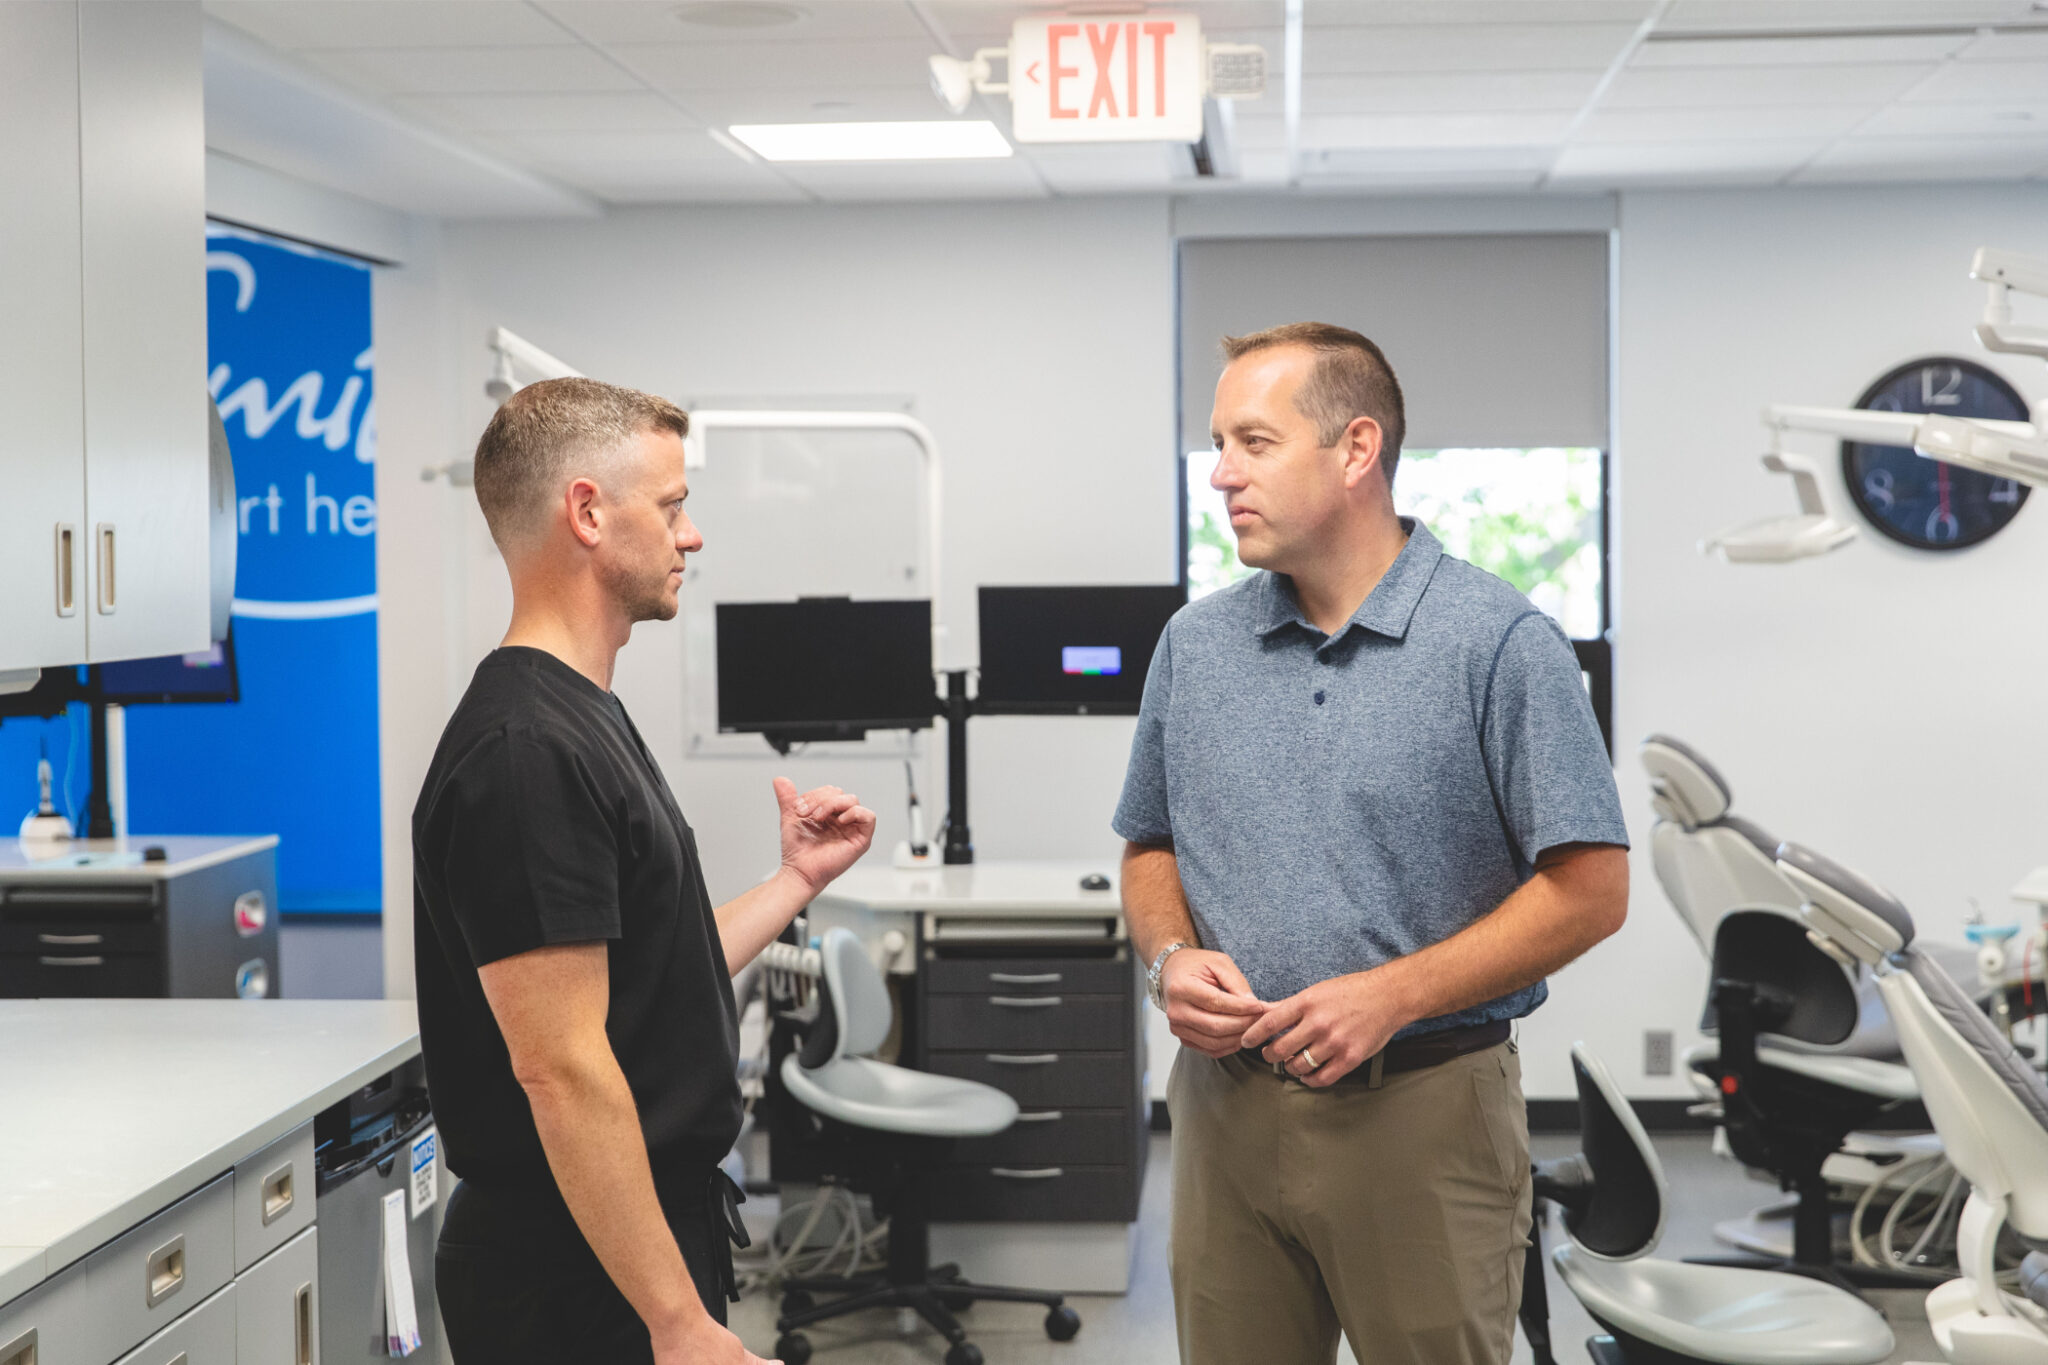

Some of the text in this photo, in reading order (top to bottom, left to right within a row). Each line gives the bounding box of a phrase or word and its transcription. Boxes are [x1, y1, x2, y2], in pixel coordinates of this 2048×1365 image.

[1047, 22, 1175, 119] EXIT
[1921, 366, 1962, 406] 12
[1864, 468, 1895, 516] 8
